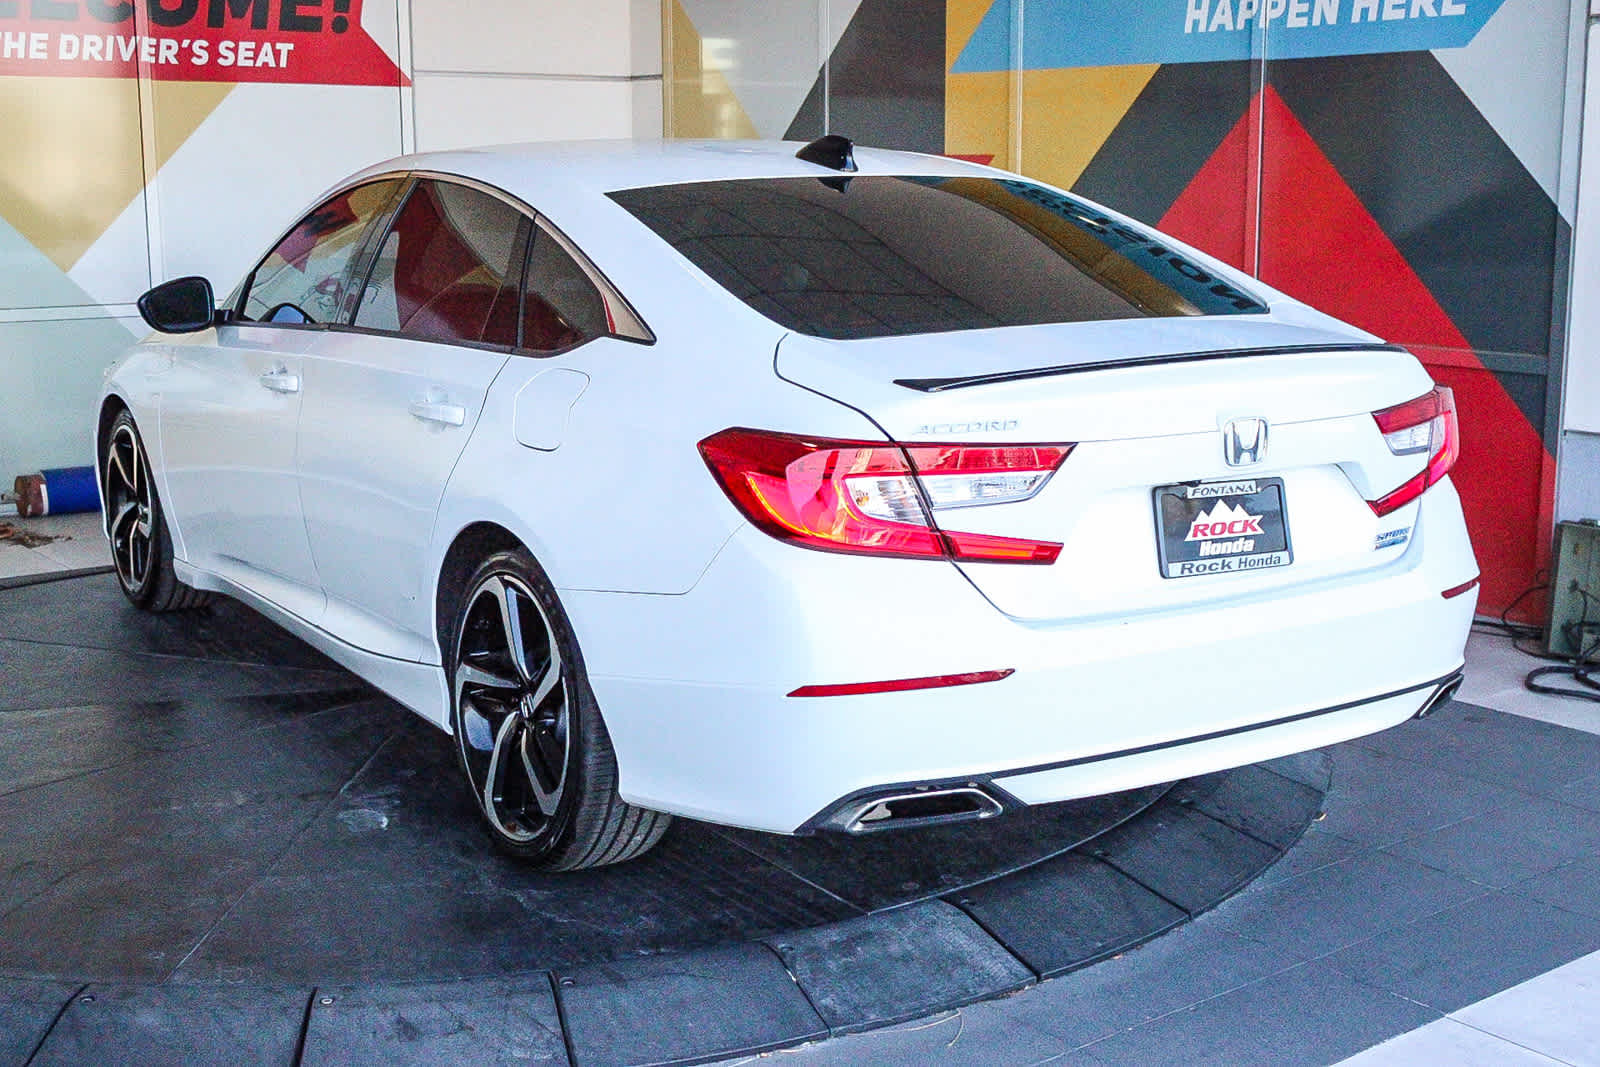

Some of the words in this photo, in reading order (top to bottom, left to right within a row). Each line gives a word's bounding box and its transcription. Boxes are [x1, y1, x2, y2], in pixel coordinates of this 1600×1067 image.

[0, 0, 349, 34] OME!
[1184, 0, 1340, 34] HAPPEN
[0, 31, 49, 59] HE
[58, 33, 209, 66] DRIVER'S
[216, 39, 295, 68] SEAT
[1191, 484, 1255, 497] FONTANA
[1192, 519, 1259, 538] ROCK
[1199, 537, 1256, 557] Honda
[1180, 559, 1233, 575] Rock
[1238, 554, 1281, 569] Honda
